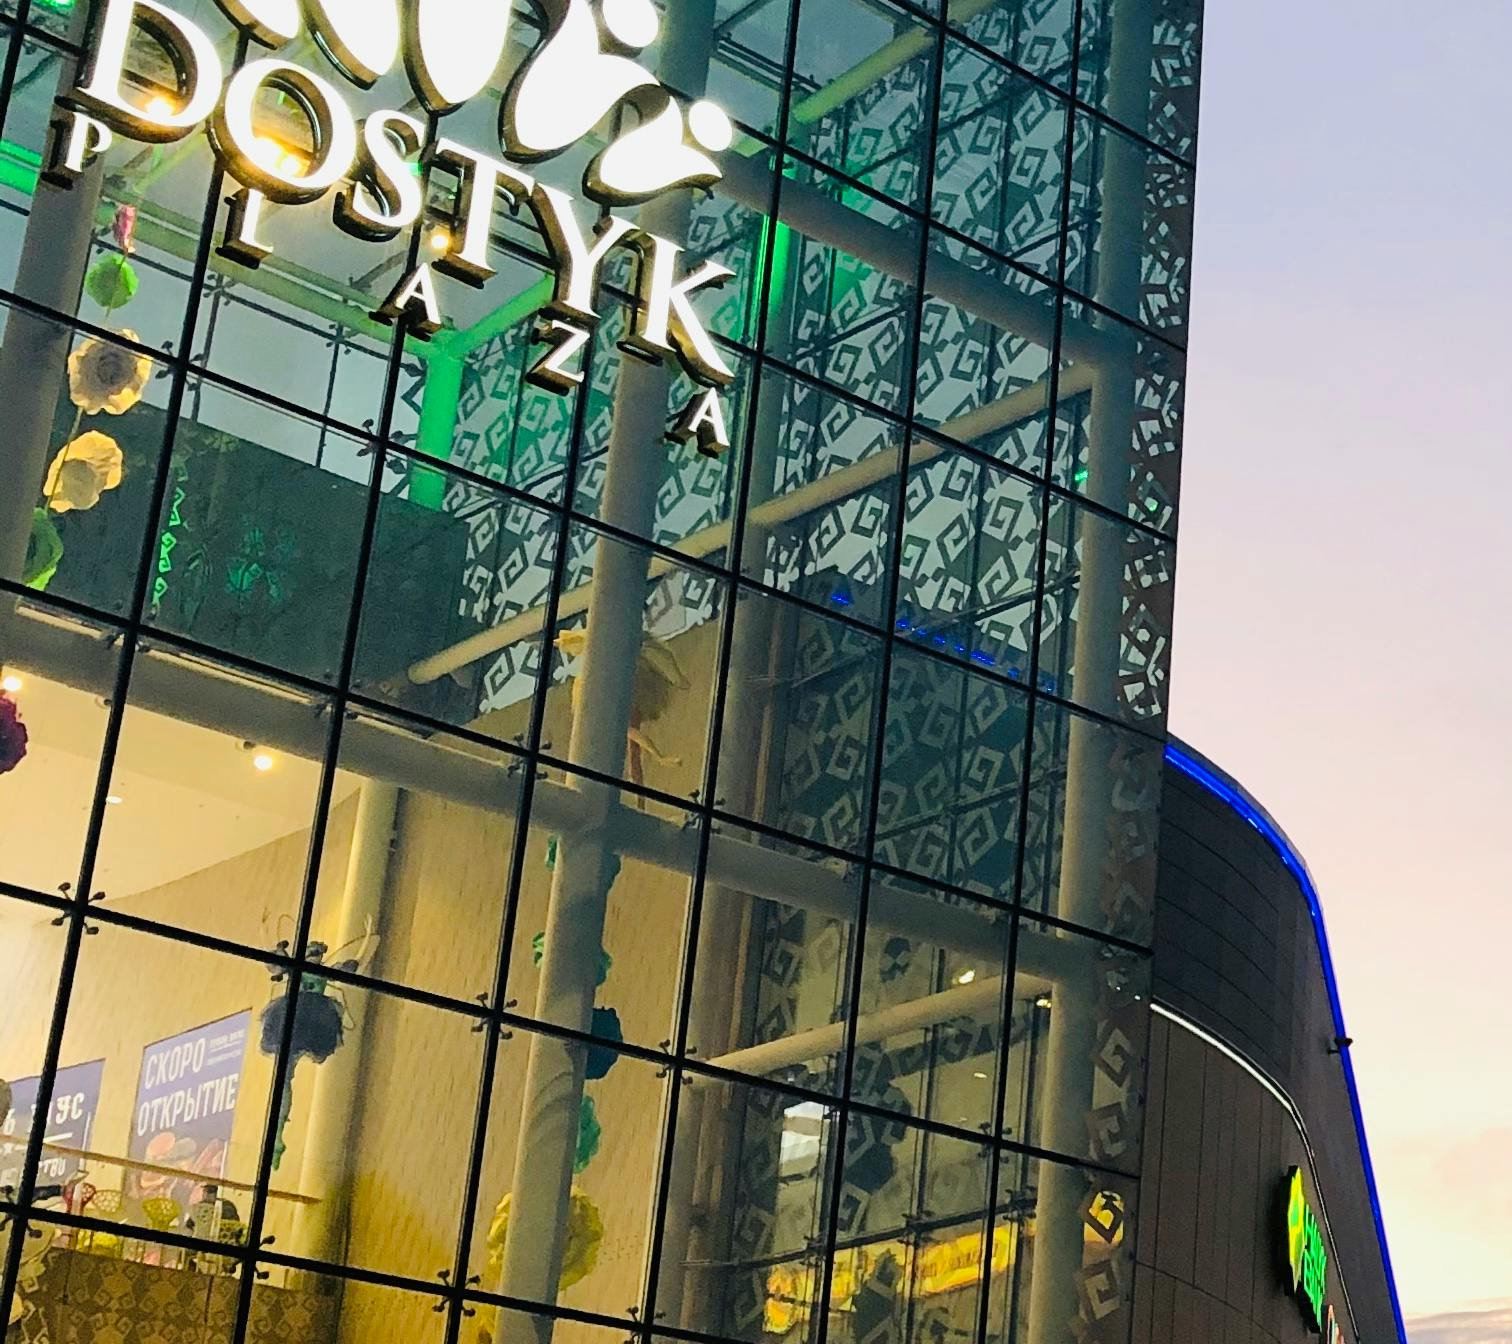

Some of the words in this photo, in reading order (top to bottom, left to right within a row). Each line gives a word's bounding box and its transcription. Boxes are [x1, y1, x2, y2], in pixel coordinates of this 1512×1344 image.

[62, 111, 732, 451] PLAZA
[144, 1036, 206, 1090] СКОРО
[137, 1072, 239, 1137] ОТКРЫТИЕ
